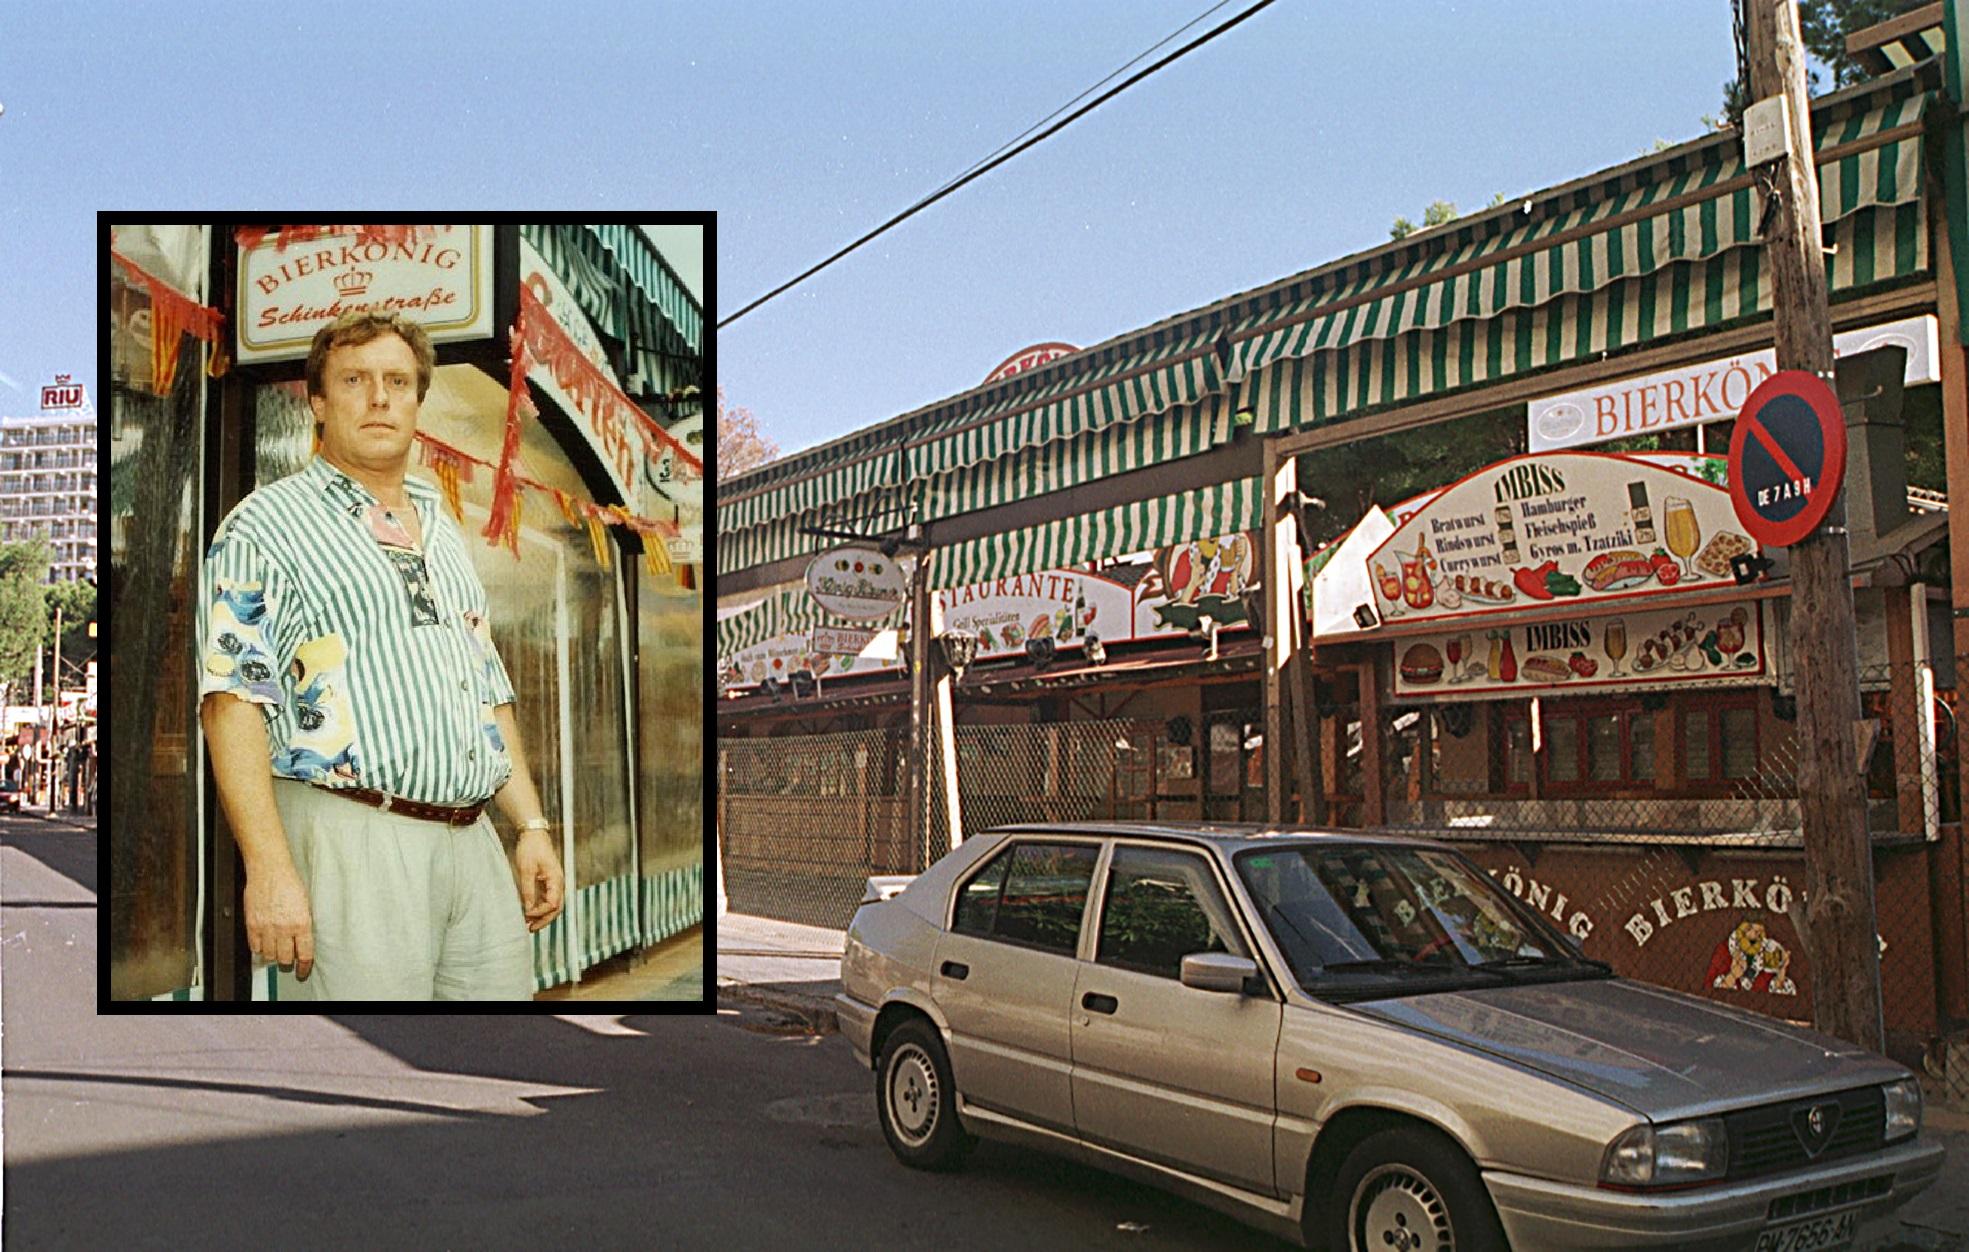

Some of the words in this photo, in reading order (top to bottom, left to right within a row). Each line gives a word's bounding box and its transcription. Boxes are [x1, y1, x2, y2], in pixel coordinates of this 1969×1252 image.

[44, 389, 80, 405] RIU
[1592, 358, 1773, 437] BIERKÖ
[1494, 463, 1566, 503] IMBISS
[1757, 487, 1771, 507] DE
[1773, 485, 1781, 503] 7
[1783, 482, 1792, 500] A
[1802, 476, 1812, 495] H
[1520, 496, 1587, 518] Hamburger
[1431, 513, 1486, 534] Bratwurst
[1525, 512, 1597, 539] Fleischspieß
[1435, 532, 1496, 553] Rindswurst
[1529, 543, 1565, 562] Gyros
[1583, 529, 1633, 552] Tzatziki
[1440, 552, 1502, 573] Currywurst
[1526, 620, 1592, 652] IMBISS
